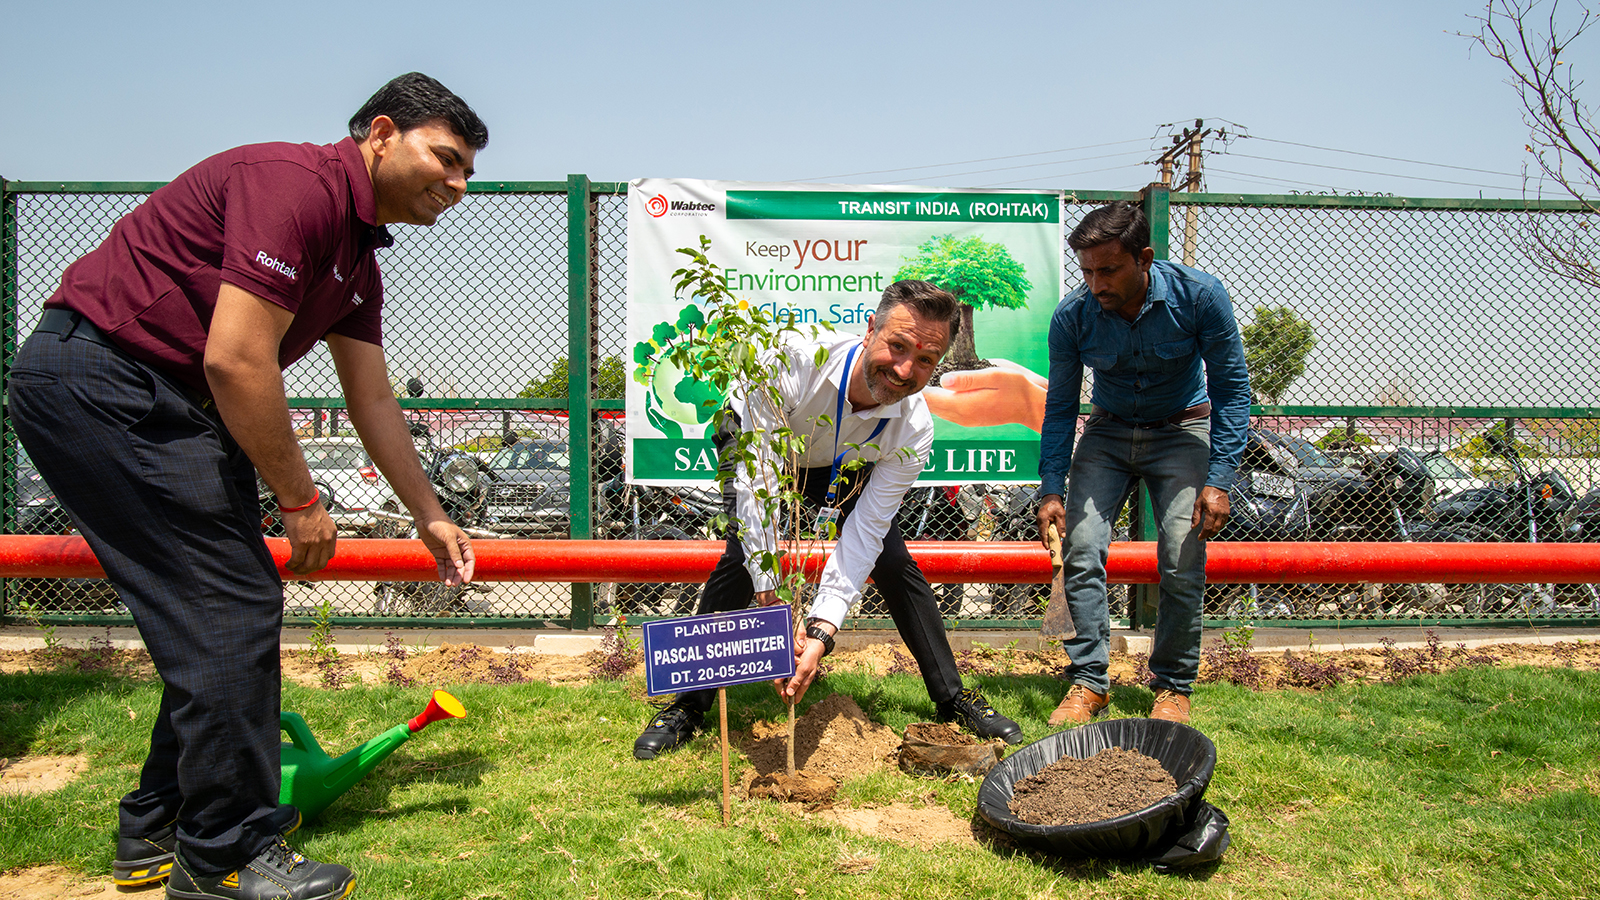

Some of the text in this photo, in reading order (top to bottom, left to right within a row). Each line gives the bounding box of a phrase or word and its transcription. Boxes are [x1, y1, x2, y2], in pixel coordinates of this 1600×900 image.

[671, 201, 715, 211] Wabtec
[838, 201, 1049, 220] TRANSIT INDIA (ROHTAK)
[255, 250, 298, 280] Rohtak
[746, 239, 867, 270] Keep your
[724, 268, 883, 291] Environment
[945, 449, 1016, 472] LIFE
[674, 617, 765, 638] PLANTED BY:-
[654, 634, 785, 666] PASCAL SCHWEITZER
[670, 659, 773, 685] DT. 20-05-2024
